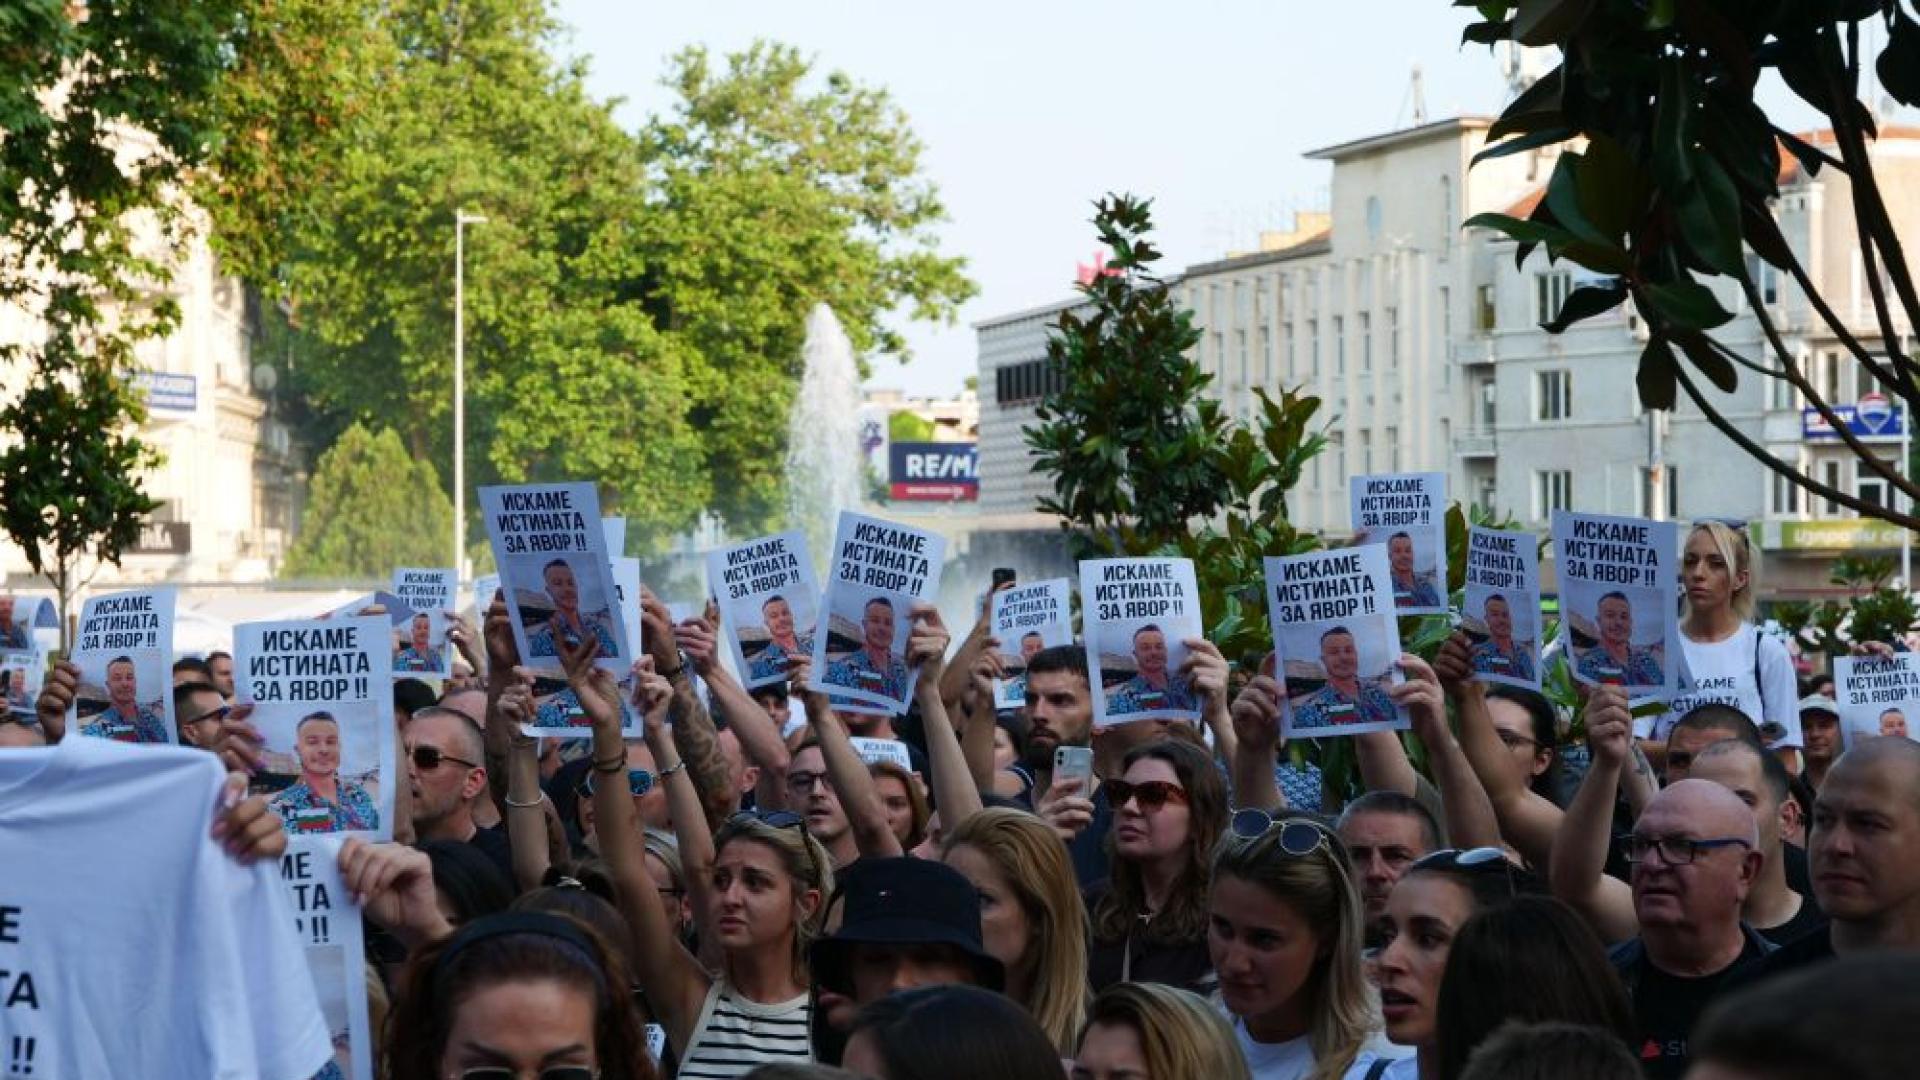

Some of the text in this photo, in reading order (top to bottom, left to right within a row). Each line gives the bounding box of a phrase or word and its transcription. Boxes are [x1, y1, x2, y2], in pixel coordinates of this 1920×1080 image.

[1367, 478, 1423, 495] ИСКАМЕ
[501, 491, 572, 511] ИСКАМЕ
[1361, 494, 1431, 510] ИСТИНАТА
[497, 512, 585, 533] ИСТИНАТА
[1363, 510, 1429, 526] ЗА ЯВОР !!
[854, 522, 927, 554] ИСКАМЕ
[1574, 520, 1648, 545] ИСКАМЕ
[504, 533, 586, 553] ЗА ЯВОР !!
[726, 538, 786, 566] ИСКАМЕ
[1565, 539, 1658, 566] ИСТИНАТА
[723, 552, 799, 583] ИСТИНАТА
[843, 541, 928, 577] ИСТИНАТА
[1283, 554, 1362, 581] ИСКАМЕ
[841, 562, 922, 596] ЗА ЯВОР !!
[1103, 564, 1173, 581] ИСКАМЕ
[1517, 575, 1524, 589] !!
[1567, 560, 1655, 586] ЗА ЯВОР !!
[729, 569, 799, 599] ЗА ЯВОР !!
[1096, 583, 1183, 601] ИСТИНАТА
[1277, 574, 1375, 602] ИСТИНАТА
[1005, 585, 1050, 604] ИСКАМЕ
[93, 596, 152, 616] ИСКАМЕ
[998, 598, 1057, 618] ИСТИНАТА
[1099, 600, 1183, 620] ЗА ЯВОР !!
[1281, 596, 1375, 622] ЗА ЯВОР !!
[84, 614, 158, 633] ИСТИНАТА
[1016, 612, 1046, 627] ЯВОР
[82, 631, 156, 650] ЗА ЯВОР !!
[263, 627, 358, 652] ИСКАМЕ
[250, 652, 370, 677] ИСТИНАТА
[252, 677, 368, 701] ЗА ЯВОР !!
[1847, 672, 1919, 690] ИСТИНАТА
[1851, 687, 1919, 704] ЗА ЯВОР !!
[11, 1036, 36, 1075] !!
